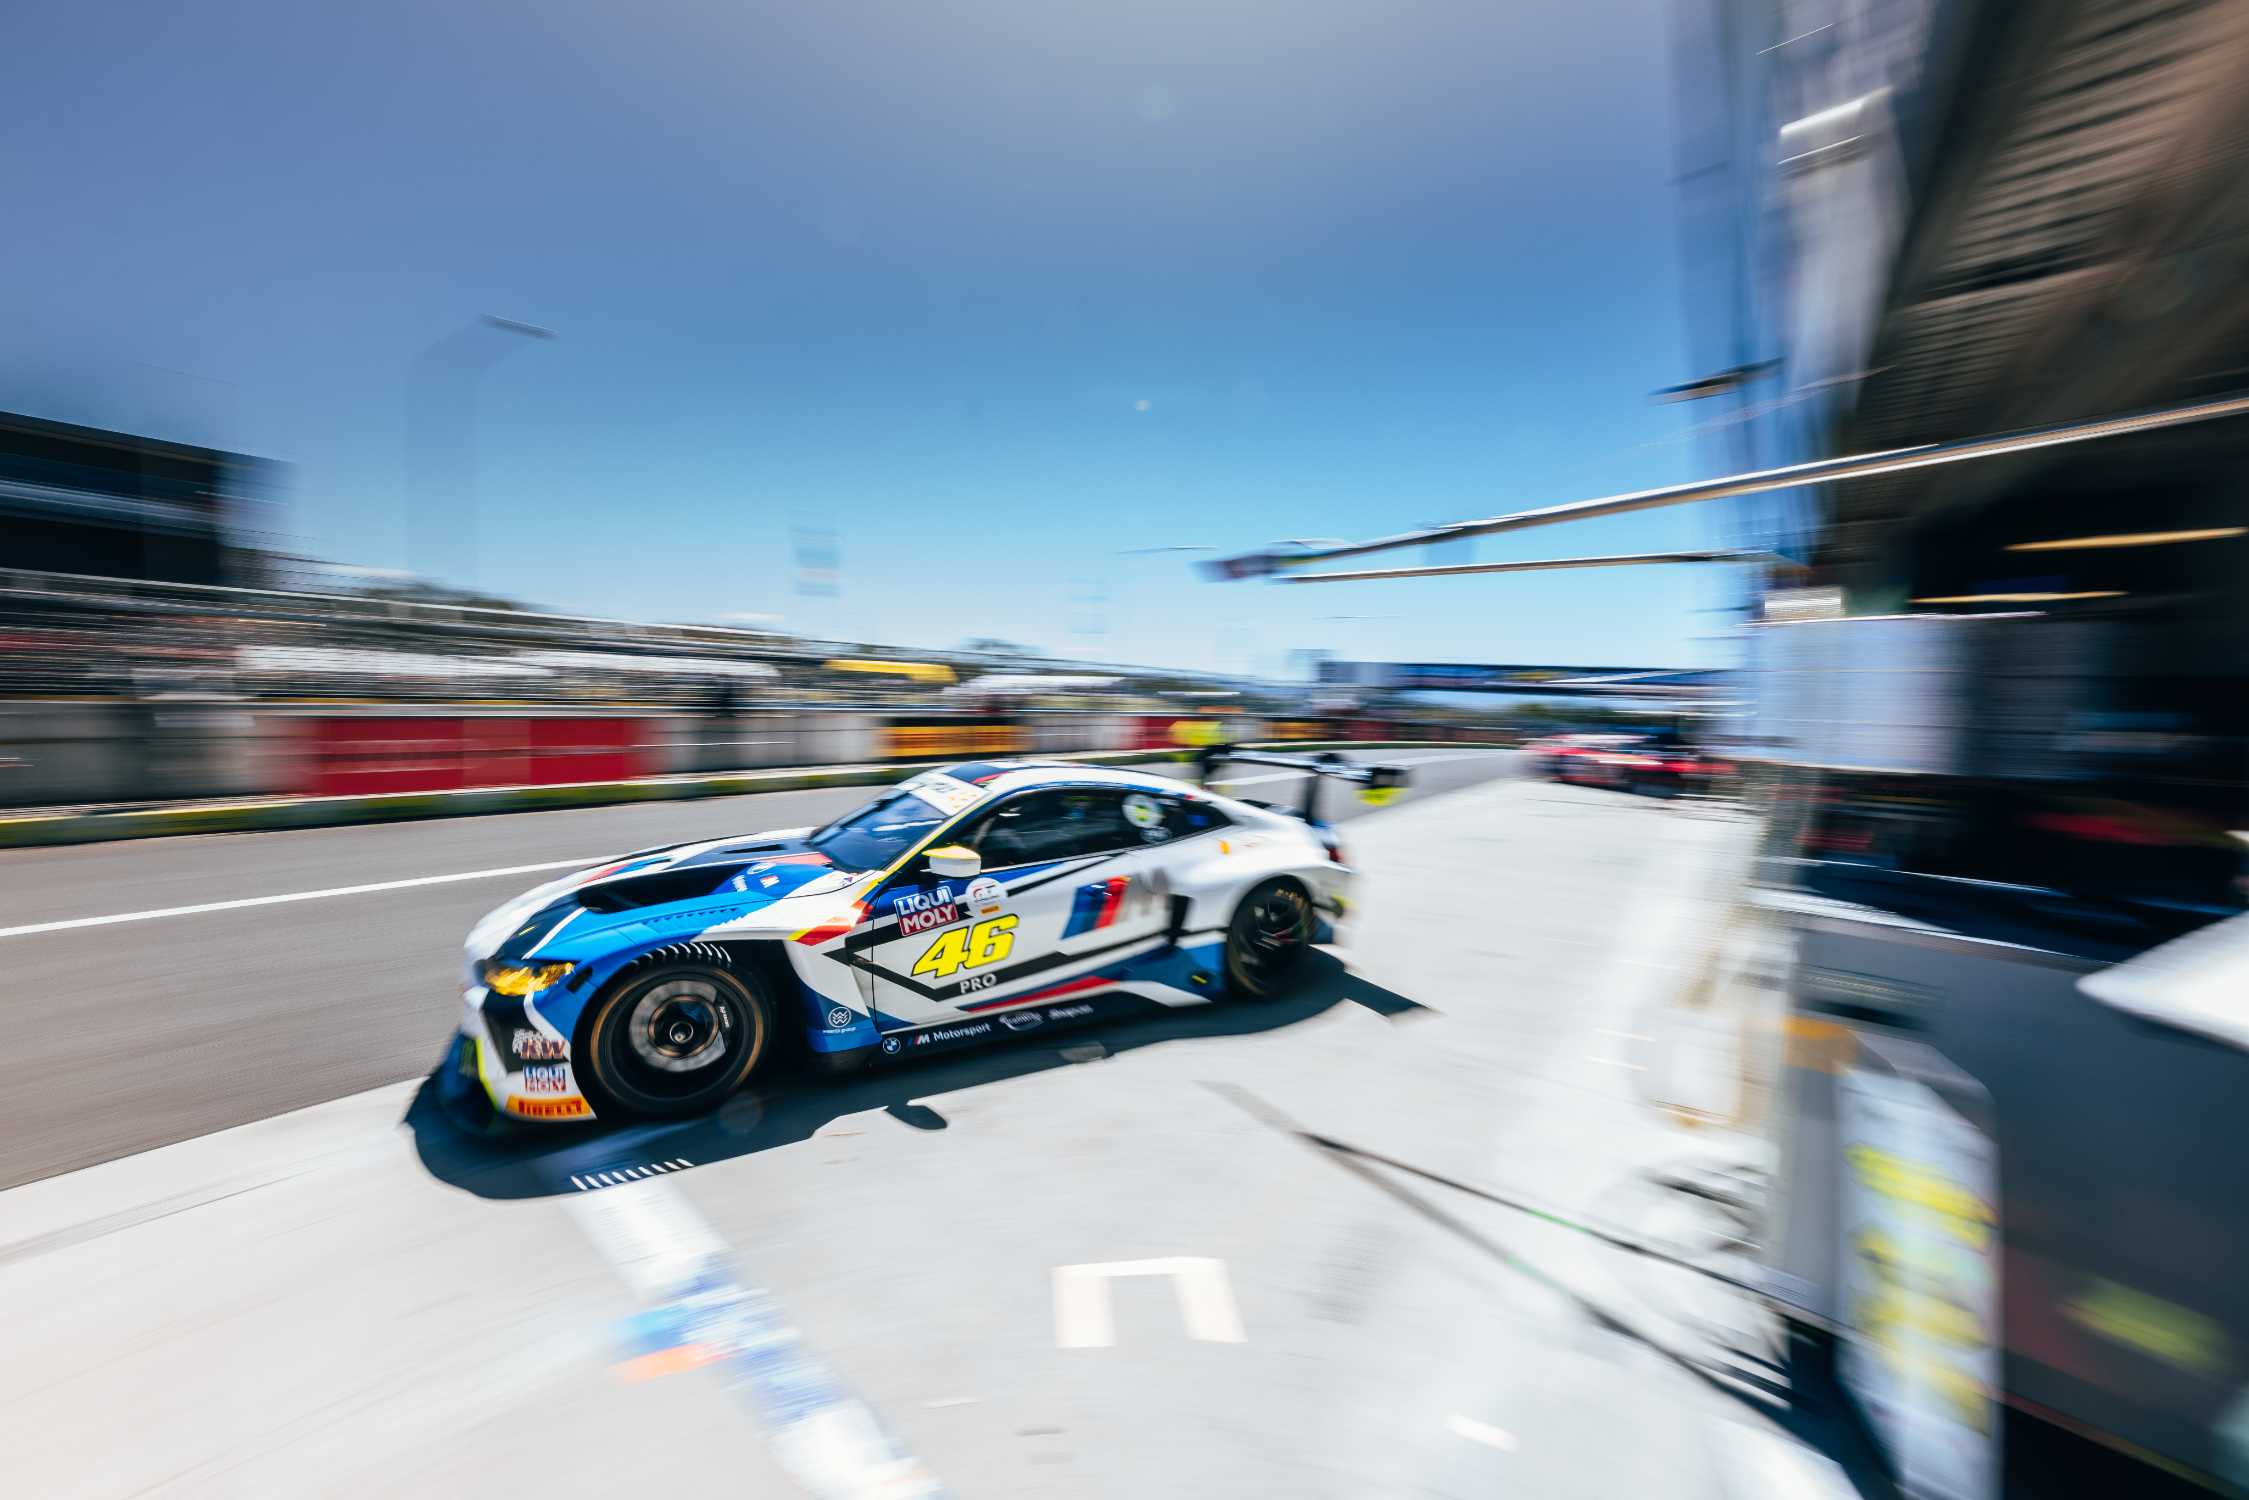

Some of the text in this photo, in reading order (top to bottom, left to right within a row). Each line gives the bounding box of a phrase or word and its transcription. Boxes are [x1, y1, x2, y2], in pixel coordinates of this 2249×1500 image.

[897, 887, 951, 915] LIQUI
[902, 904, 954, 933] MOLY
[911, 913, 1020, 978] 46
[960, 973, 997, 994] PRO
[933, 1022, 991, 1042] Motorsport
[520, 1039, 565, 1059] KW
